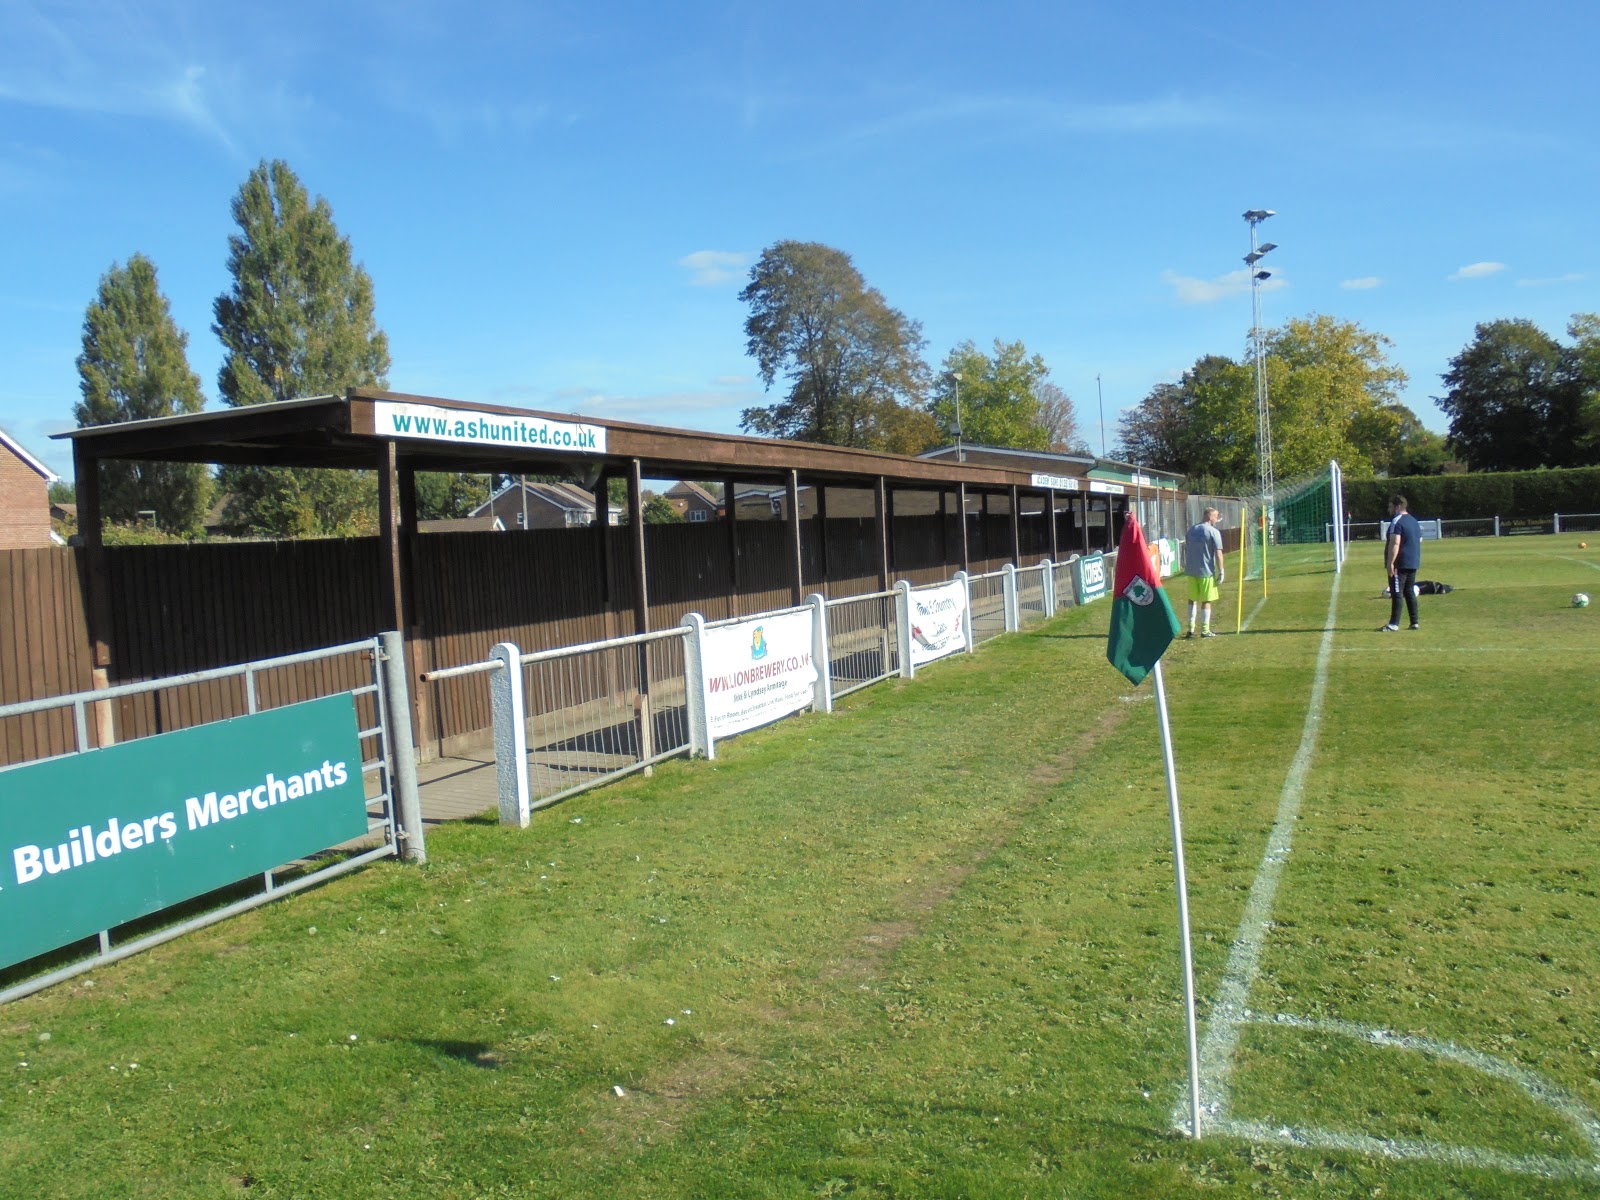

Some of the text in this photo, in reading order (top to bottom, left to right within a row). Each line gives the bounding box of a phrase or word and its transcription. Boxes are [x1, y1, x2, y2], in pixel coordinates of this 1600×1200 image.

[392, 413, 596, 448] www.ashunited.co.uk
[12, 759, 348, 886] Builders Merchants
